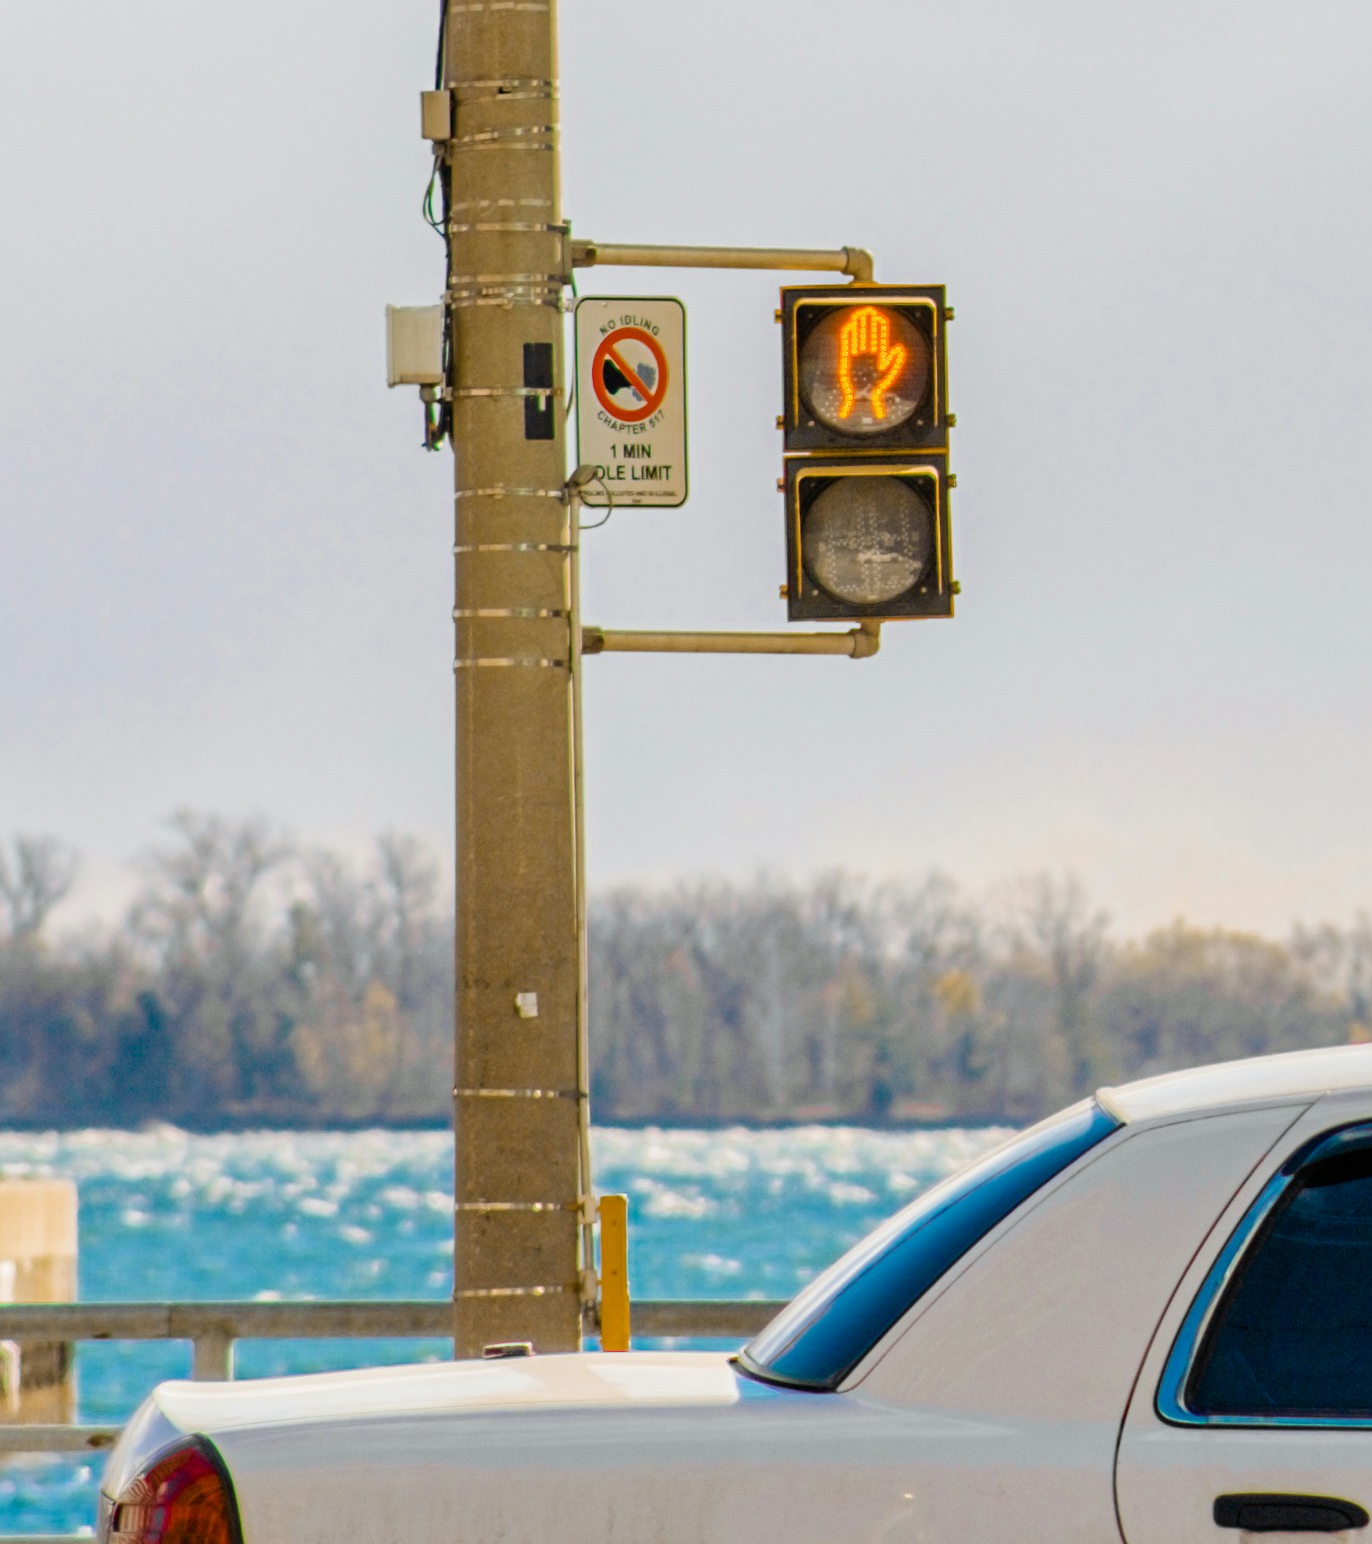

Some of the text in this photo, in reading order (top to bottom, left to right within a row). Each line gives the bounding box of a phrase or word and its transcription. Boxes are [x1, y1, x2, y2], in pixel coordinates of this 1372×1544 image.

[599, 315, 660, 336] NO IDLING
[597, 410, 665, 434] CHAPTER 517
[610, 444, 652, 459] 1 MIN
[595, 465, 672, 481] DLE LIMIT
